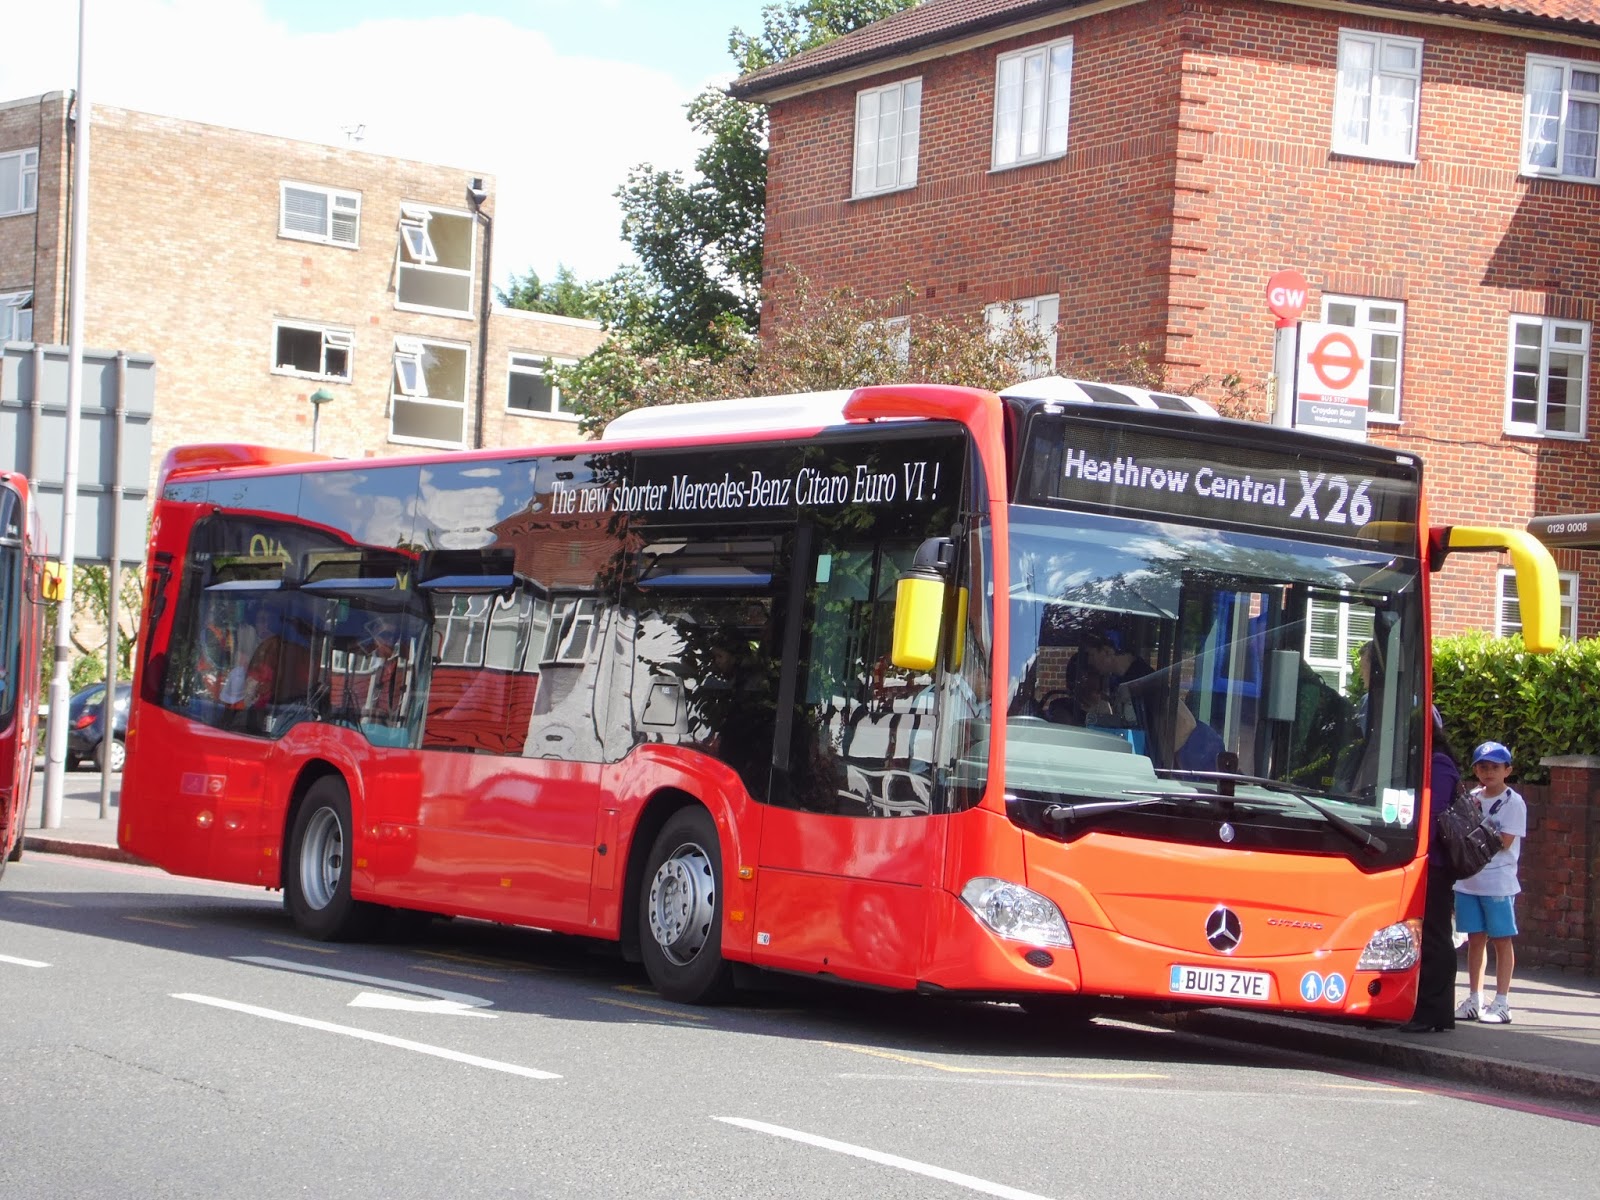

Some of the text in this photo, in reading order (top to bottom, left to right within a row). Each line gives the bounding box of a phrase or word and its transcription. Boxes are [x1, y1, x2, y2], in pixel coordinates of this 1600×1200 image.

[1270, 287, 1305, 308] GW
[1321, 394, 1349, 404] BUS STOP
[1311, 405, 1356, 417] Croydon Road
[550, 481, 576, 515] The
[578, 490, 611, 514] new
[612, 477, 667, 512] shorter
[668, 470, 791, 511] Mercedes-Benz
[795, 464, 849, 506] Citaro
[852, 464, 897, 504] Euro
[903, 462, 928, 501] VI
[1064, 448, 1373, 527] Heathrow Central X26
[1547, 522, 1588, 534] 0129 0008
[1267, 918, 1323, 930] CITARO
[1230, 974, 1263, 996] ZVE
